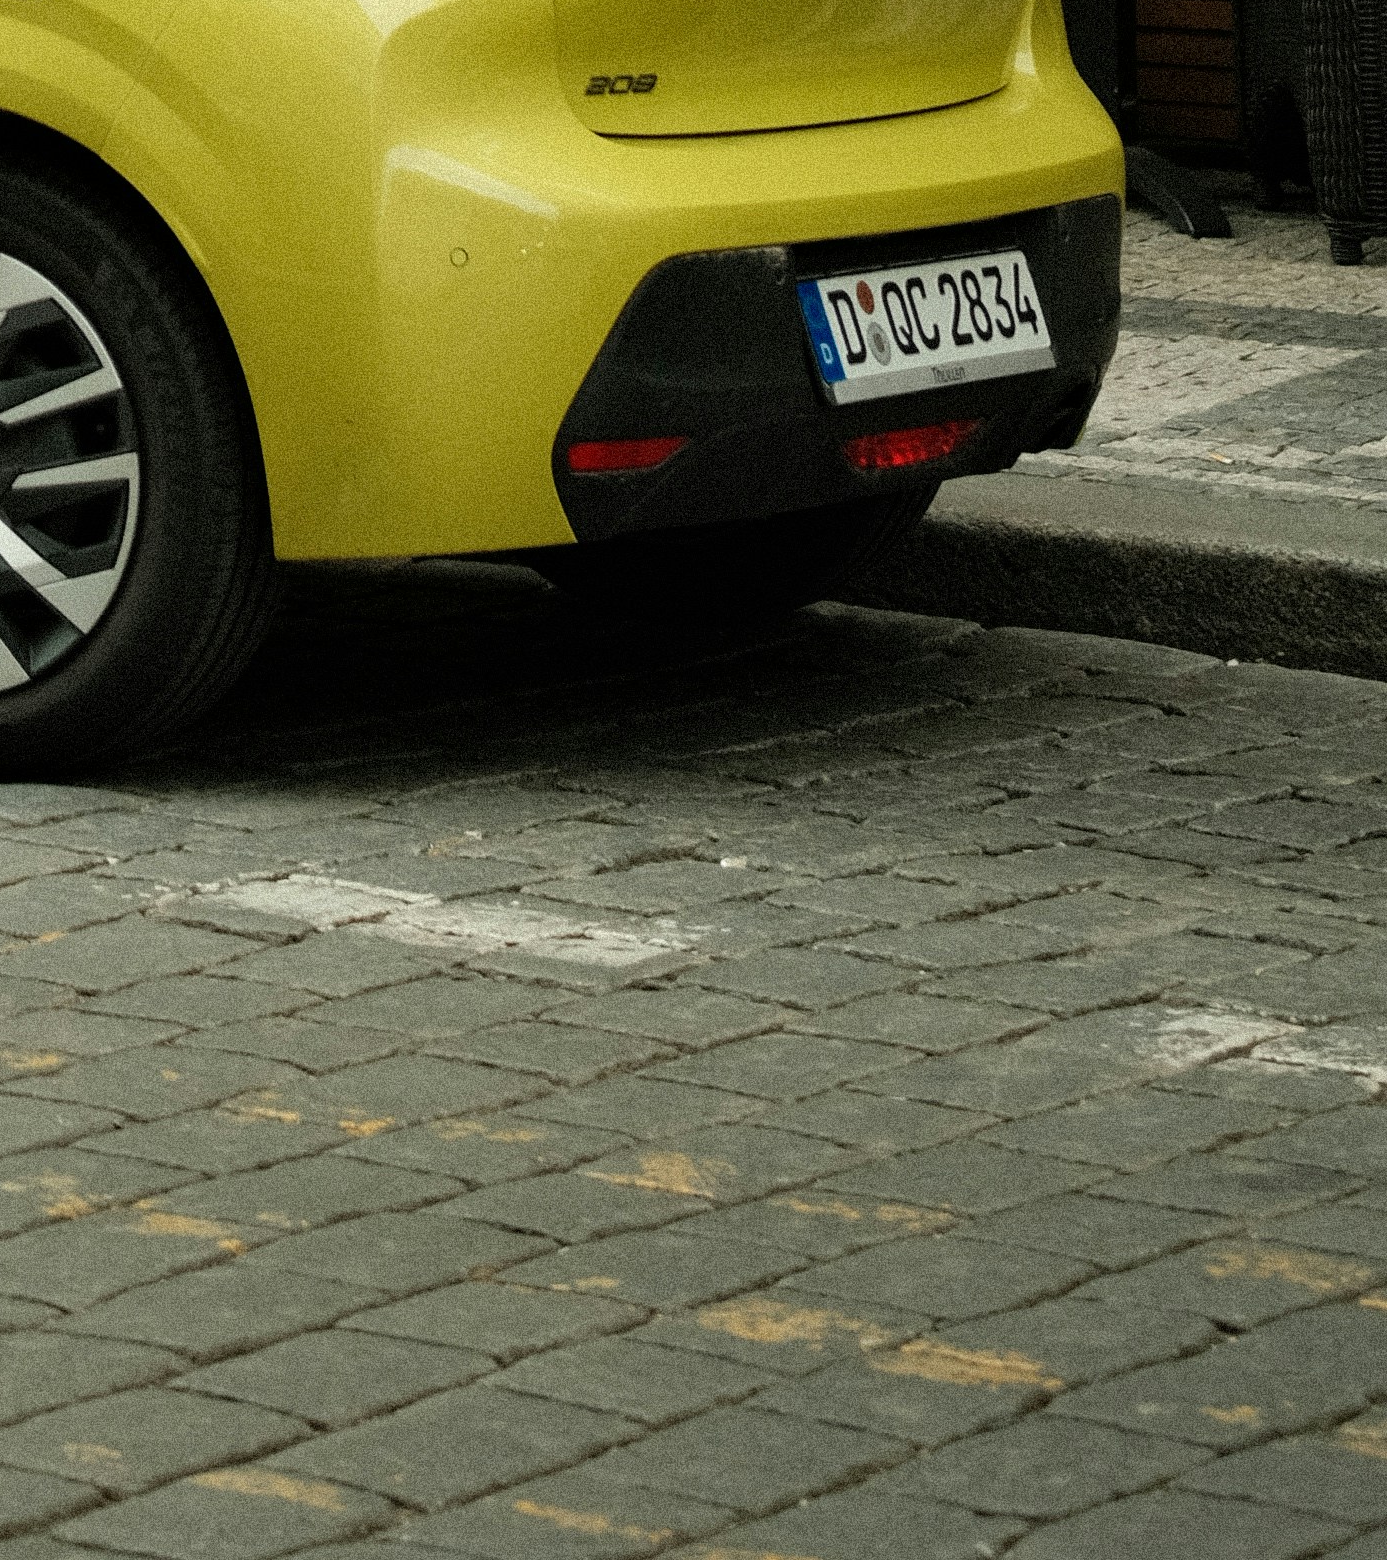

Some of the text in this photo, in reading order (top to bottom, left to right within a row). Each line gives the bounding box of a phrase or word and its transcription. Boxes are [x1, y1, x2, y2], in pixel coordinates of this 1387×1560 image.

[584, 72, 658, 97] 208
[827, 289, 867, 365] D
[937, 262, 1039, 347] 2834
[819, 341, 834, 365] D
